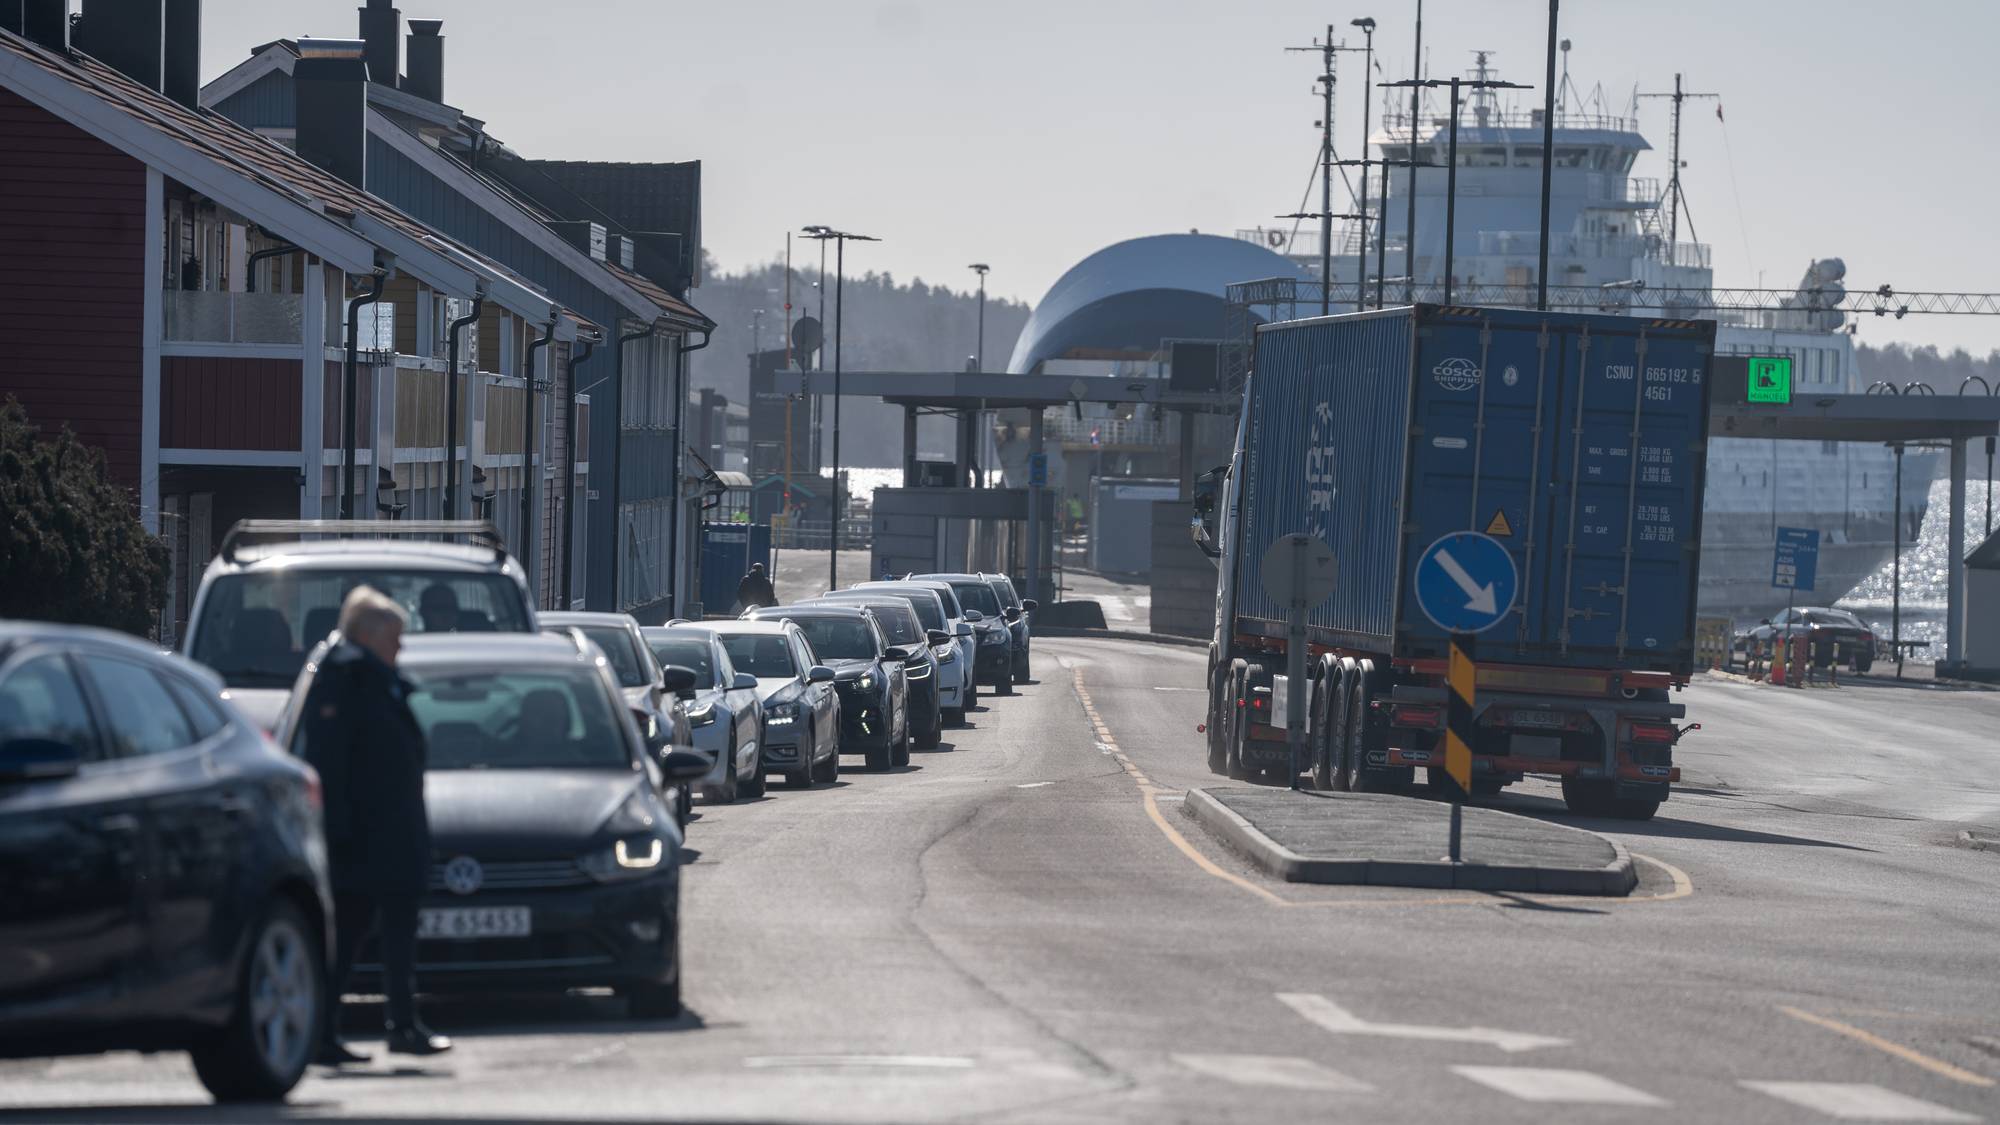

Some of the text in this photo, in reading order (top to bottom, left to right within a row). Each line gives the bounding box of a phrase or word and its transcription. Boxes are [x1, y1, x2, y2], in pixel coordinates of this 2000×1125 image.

[1432, 366, 1482, 378] COSCO
[1434, 375, 1481, 385] SHIPPING
[1606, 365, 1701, 384] CSNU 665192 5
[1645, 385, 1672, 401] 45G1
[453, 909, 525, 934] 65455
